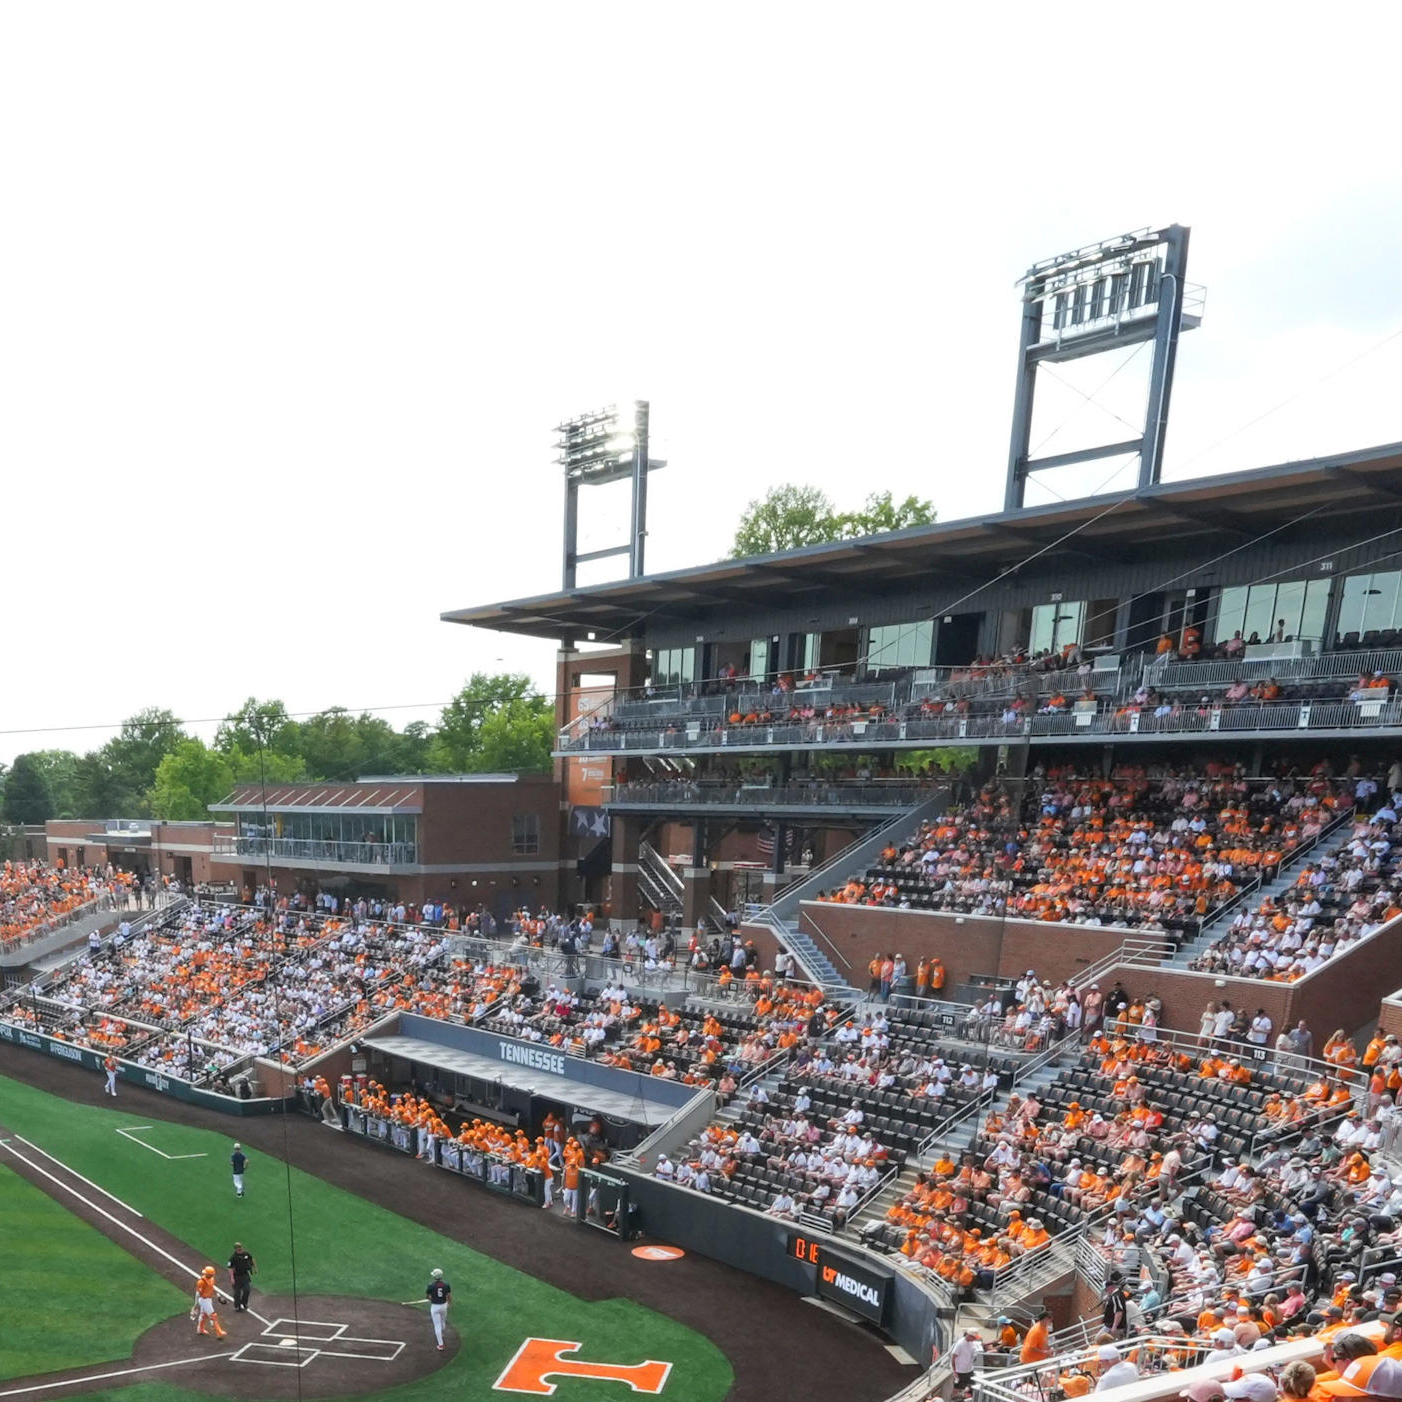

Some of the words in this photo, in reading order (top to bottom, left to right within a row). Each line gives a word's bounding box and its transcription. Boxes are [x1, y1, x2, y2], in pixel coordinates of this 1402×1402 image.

[1320, 562, 1333, 571] 311
[942, 1015, 953, 1024] 112
[499, 1042, 565, 1075] TENNESSEE
[1254, 1050, 1266, 1060] 113
[835, 1272, 880, 1307] MEDICAL
[491, 1337, 673, 1396] T
